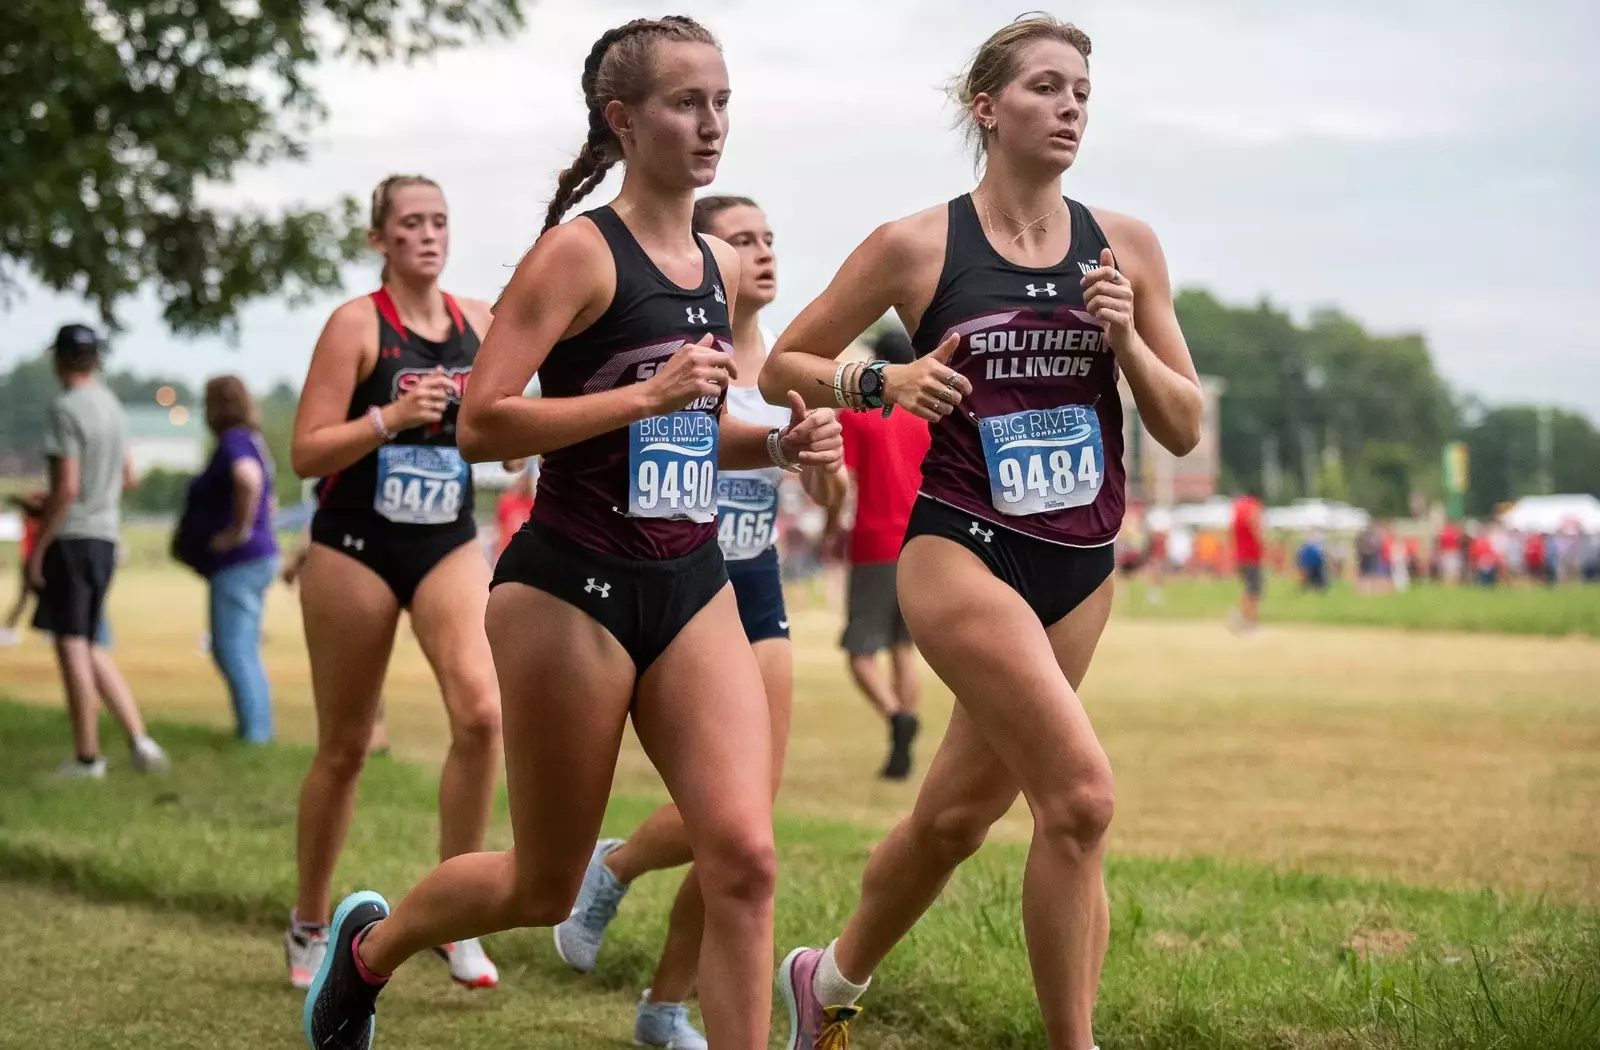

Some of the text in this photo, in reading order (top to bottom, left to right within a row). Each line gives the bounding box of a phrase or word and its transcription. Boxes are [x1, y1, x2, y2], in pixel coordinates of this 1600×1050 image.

[969, 329, 1108, 356] SOUTHERN
[985, 356, 1093, 380] ILLINOIS
[640, 416, 713, 436] BIG RIVER
[990, 407, 1087, 438] BIG RIVER
[994, 427, 1067, 444] RUNNING COMPANY
[638, 460, 714, 510] 9490
[998, 445, 1100, 503] 9484
[382, 477, 461, 513] 9478
[718, 512, 774, 549] 465
